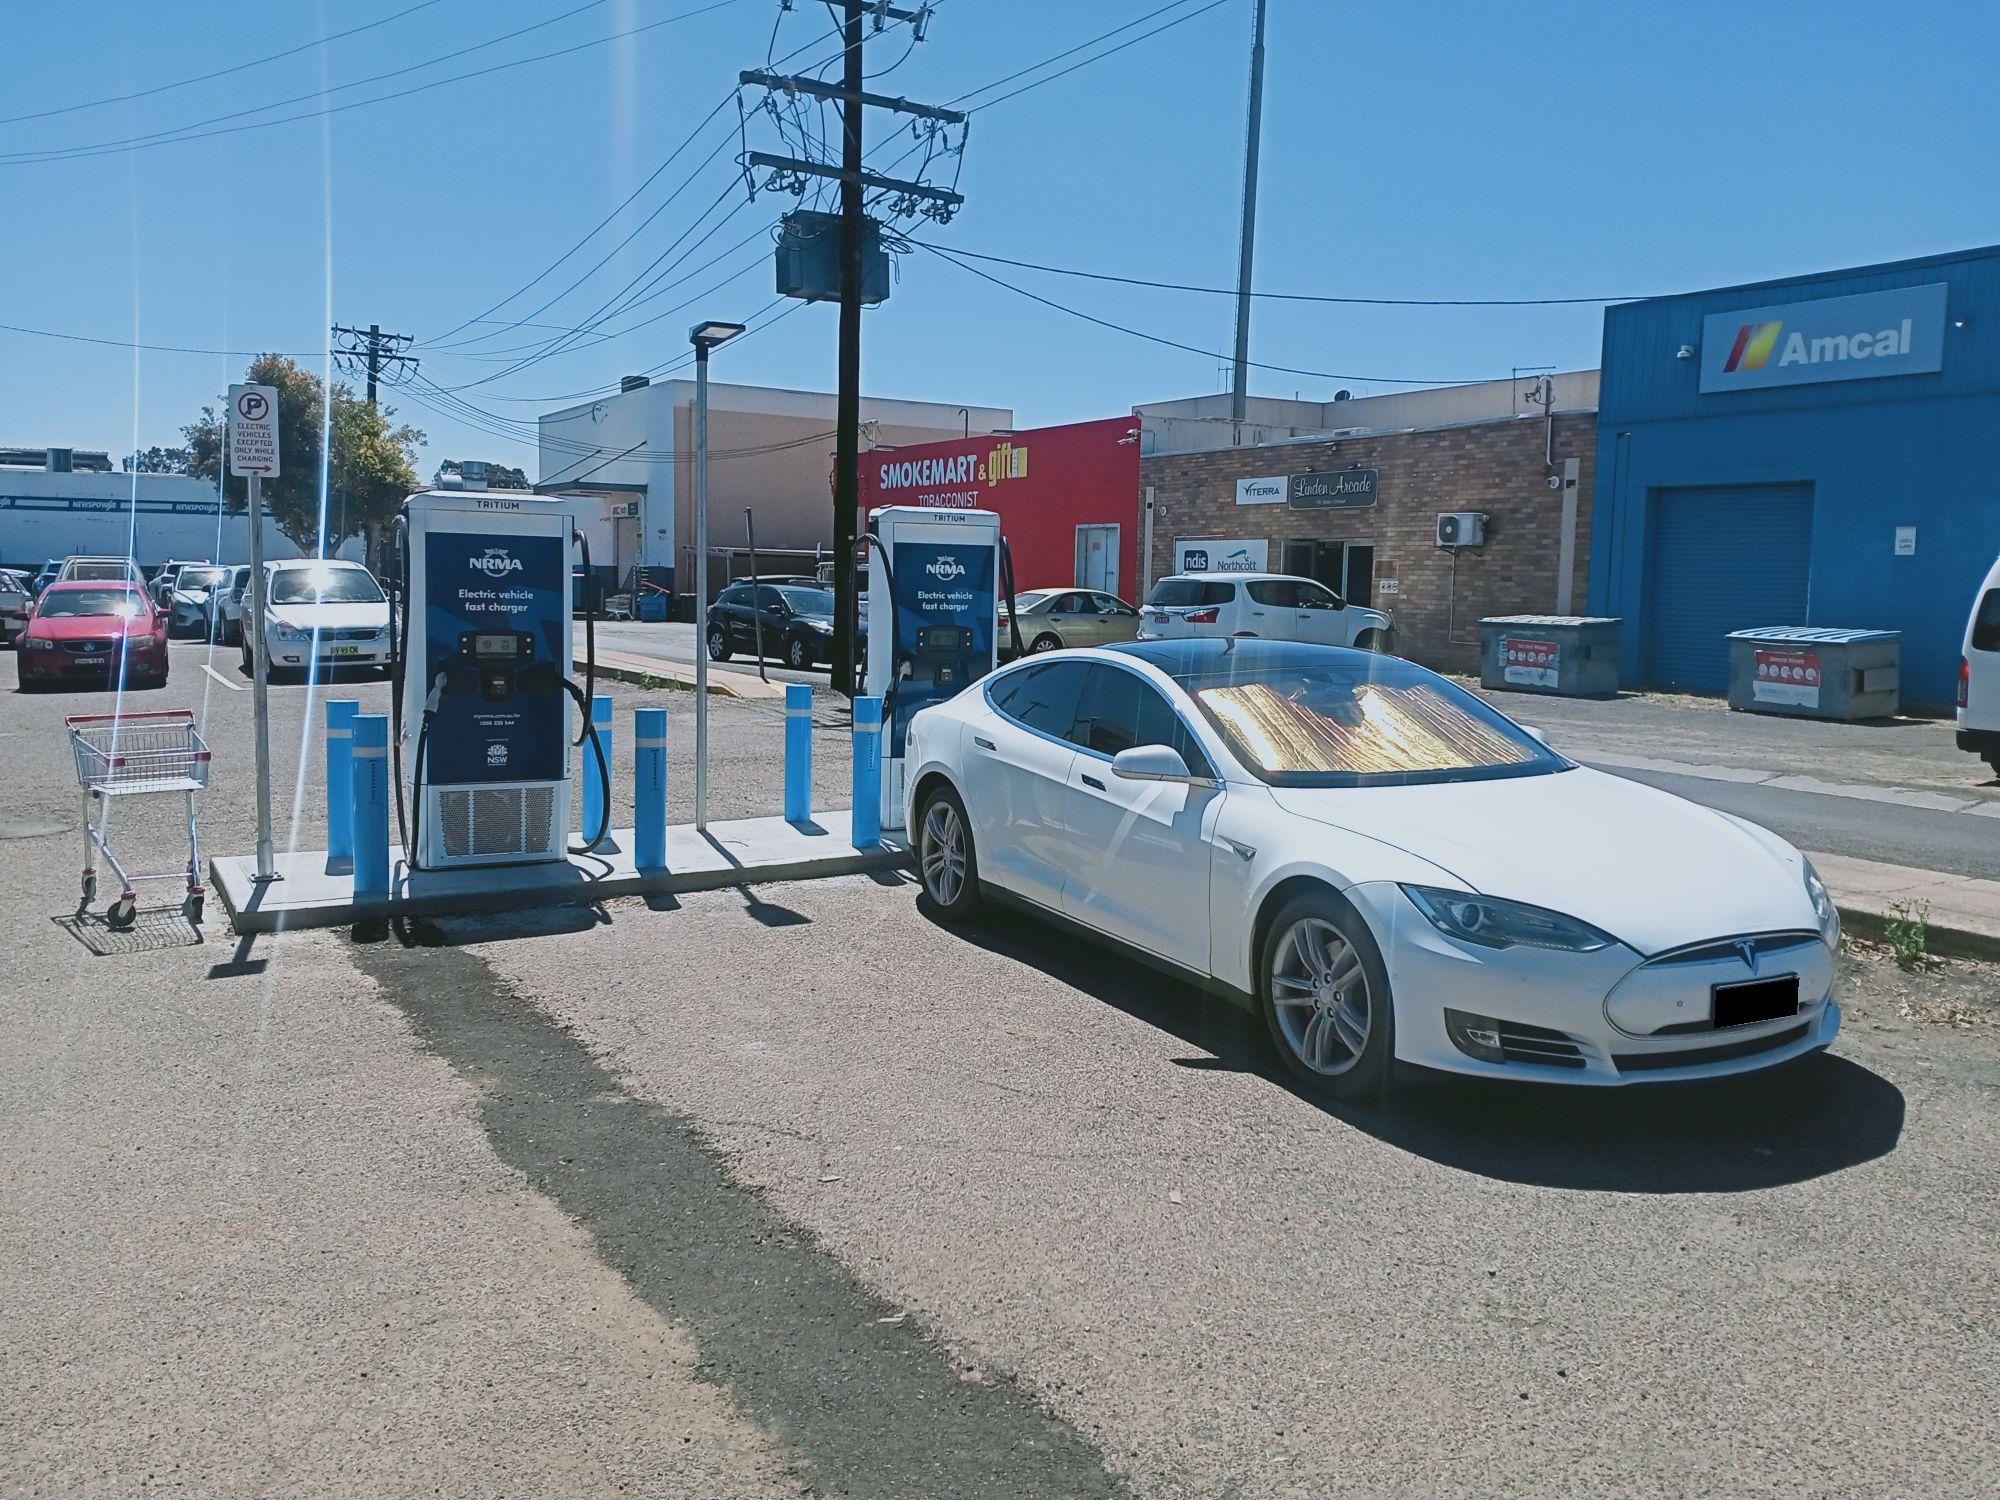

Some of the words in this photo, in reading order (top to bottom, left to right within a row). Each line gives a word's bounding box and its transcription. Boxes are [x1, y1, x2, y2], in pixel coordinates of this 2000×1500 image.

[1778, 318, 1913, 367] Amcal
[254, 447, 276, 455] WHILE
[879, 454, 978, 490] SMOKEMART
[977, 463, 987, 481] &
[988, 442, 1013, 487] gift
[1243, 481, 1280, 497] VITERRA
[1293, 477, 1329, 498] Linden
[1328, 473, 1373, 496] Arcade
[918, 490, 979, 508] TOBACCONIST
[476, 500, 520, 510] TRITIUM
[933, 514, 966, 523] TRITIUM
[469, 557, 523, 571] NRMA
[1186, 553, 1207, 569] ndis
[1217, 560, 1257, 571] Northcott
[926, 564, 966, 575] NRMA
[458, 589, 496, 599] Electric
[498, 590, 534, 600] vehicle
[917, 590, 946, 601] Electric
[947, 592, 973, 601] vehicle
[464, 602, 486, 612] fast
[488, 602, 529, 614] charger
[922, 603, 938, 611] fast
[939, 603, 969, 613] charger
